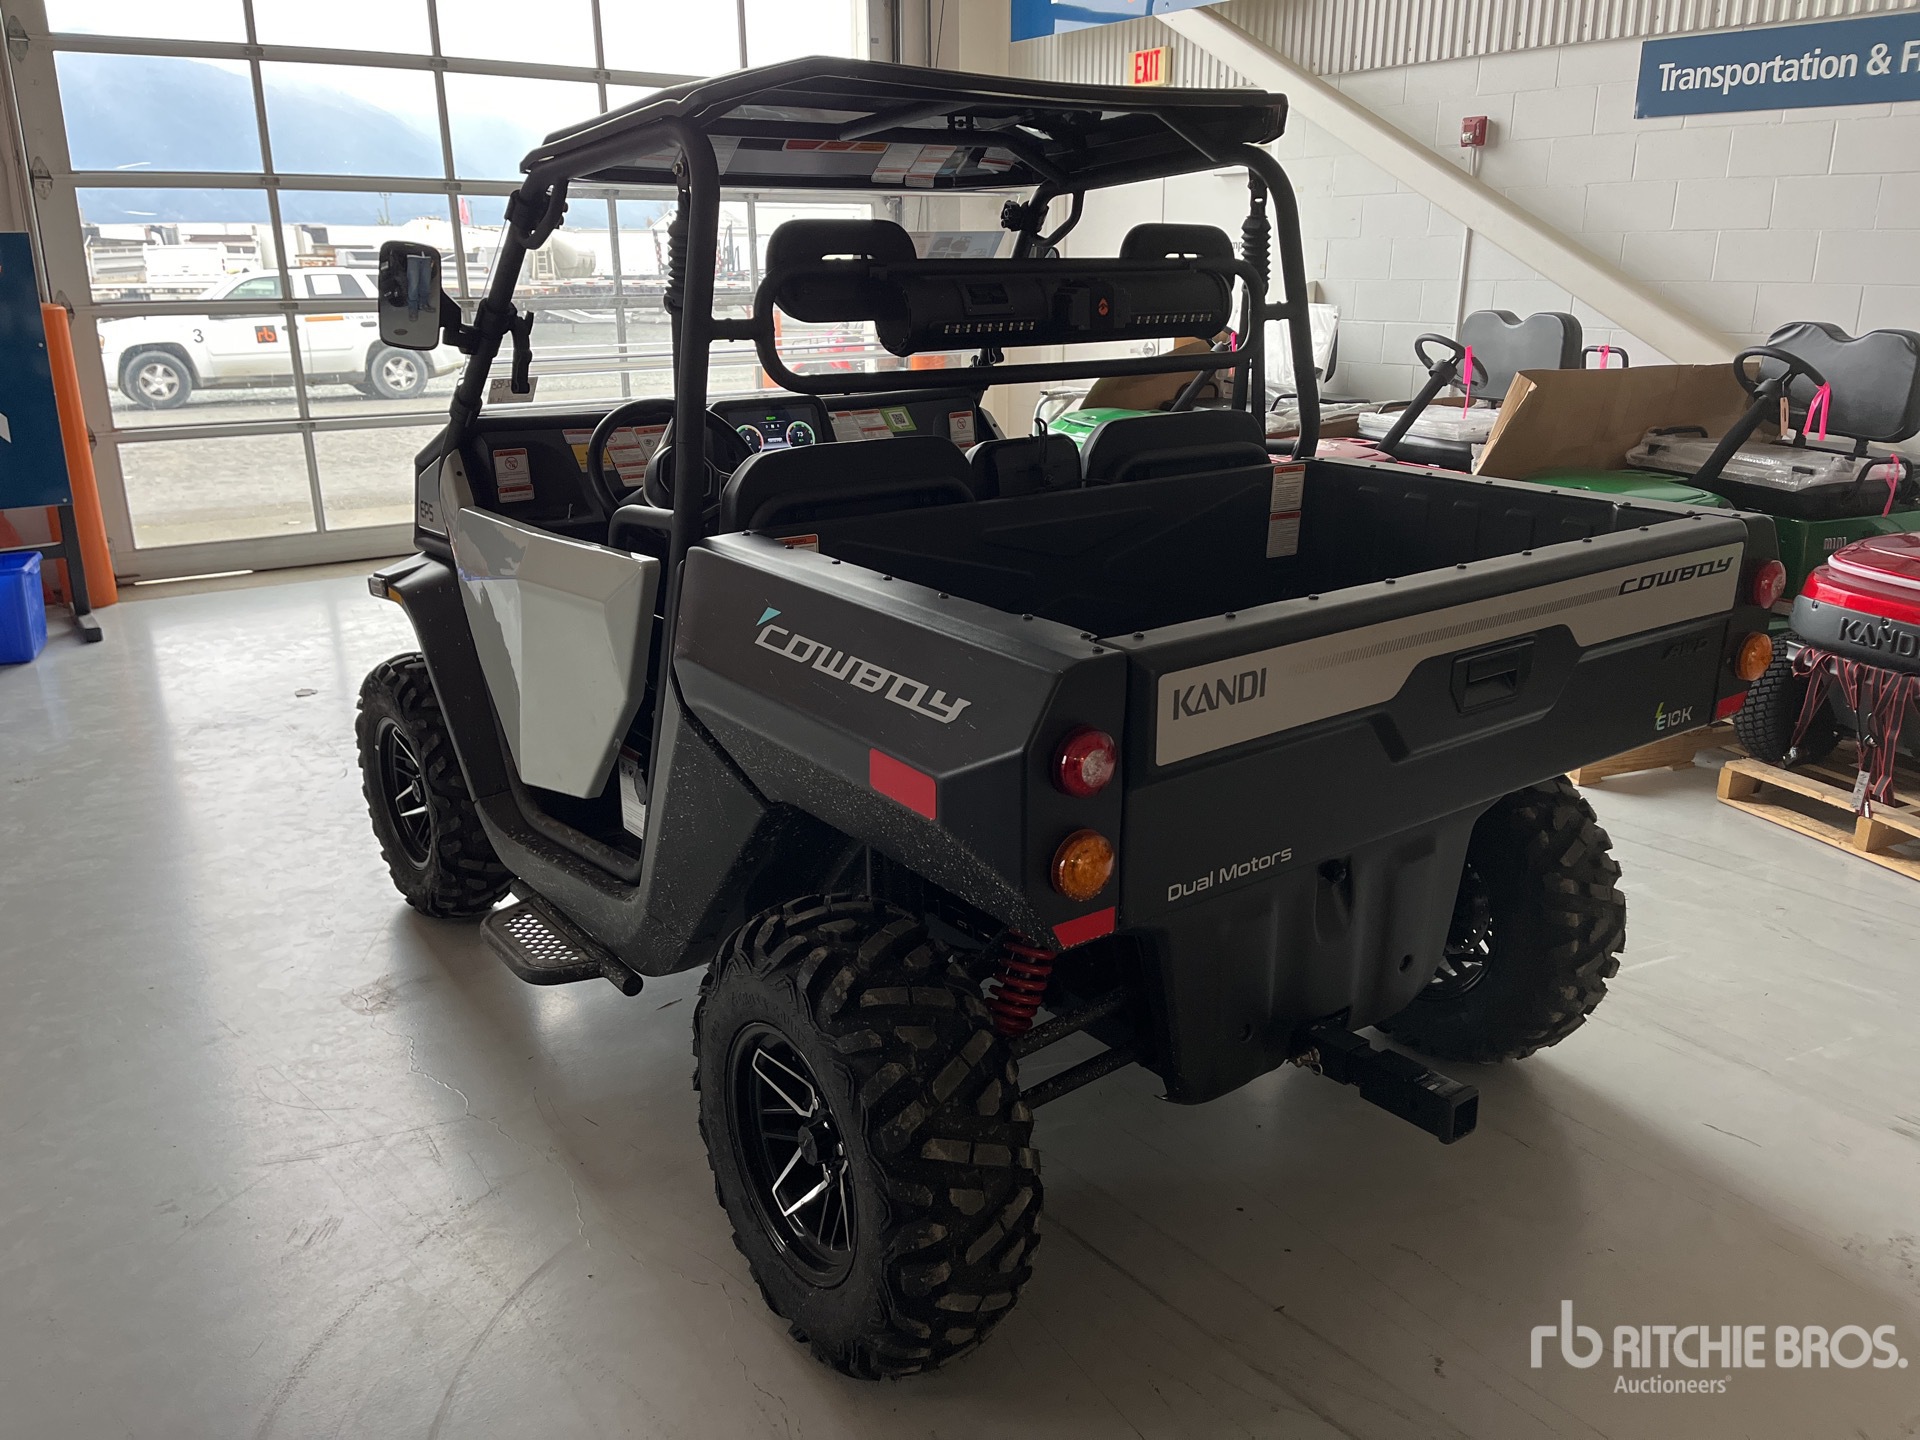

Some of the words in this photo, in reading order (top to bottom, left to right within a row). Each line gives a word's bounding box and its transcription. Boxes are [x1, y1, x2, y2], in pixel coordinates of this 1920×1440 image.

[1134, 49, 1161, 85] EXIT
[1658, 47, 1858, 95] Transportation
[1866, 43, 1892, 76] &
[1900, 40, 1920, 73] F
[192, 328, 204, 343] 3
[257, 326, 277, 343] rb
[420, 500, 434, 522] EPS
[1618, 556, 1734, 596] COWBOY
[1838, 616, 1920, 659] KAND
[754, 624, 972, 724] COWBOY
[1172, 667, 1267, 720] KANDI
[1167, 870, 1214, 902] Dual
[1219, 847, 1292, 884] Motors
